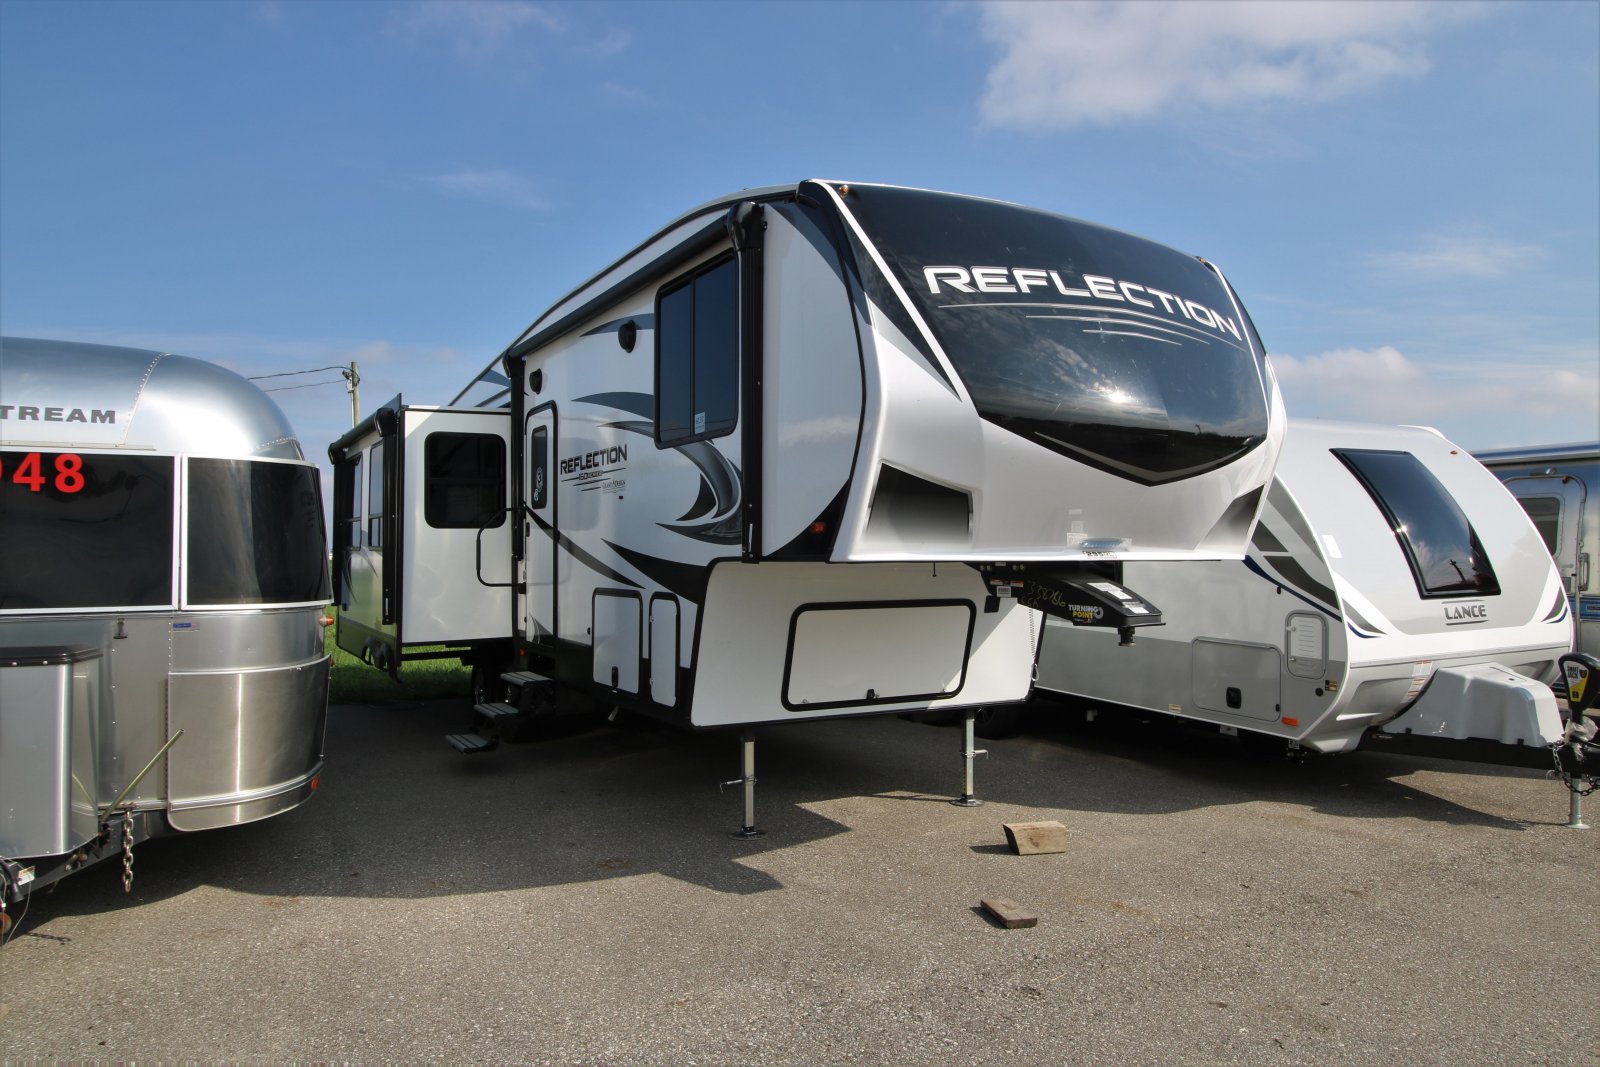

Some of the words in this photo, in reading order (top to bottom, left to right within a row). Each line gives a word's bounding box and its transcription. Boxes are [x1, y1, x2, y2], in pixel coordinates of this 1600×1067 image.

[922, 265, 1242, 341] REFLECTION
[560, 444, 627, 475] REFLECTION
[0, 452, 85, 494] 48
[1068, 604, 1098, 612] TURNING
[1072, 611, 1094, 619] POINT
[1444, 604, 1487, 620] LANCE
